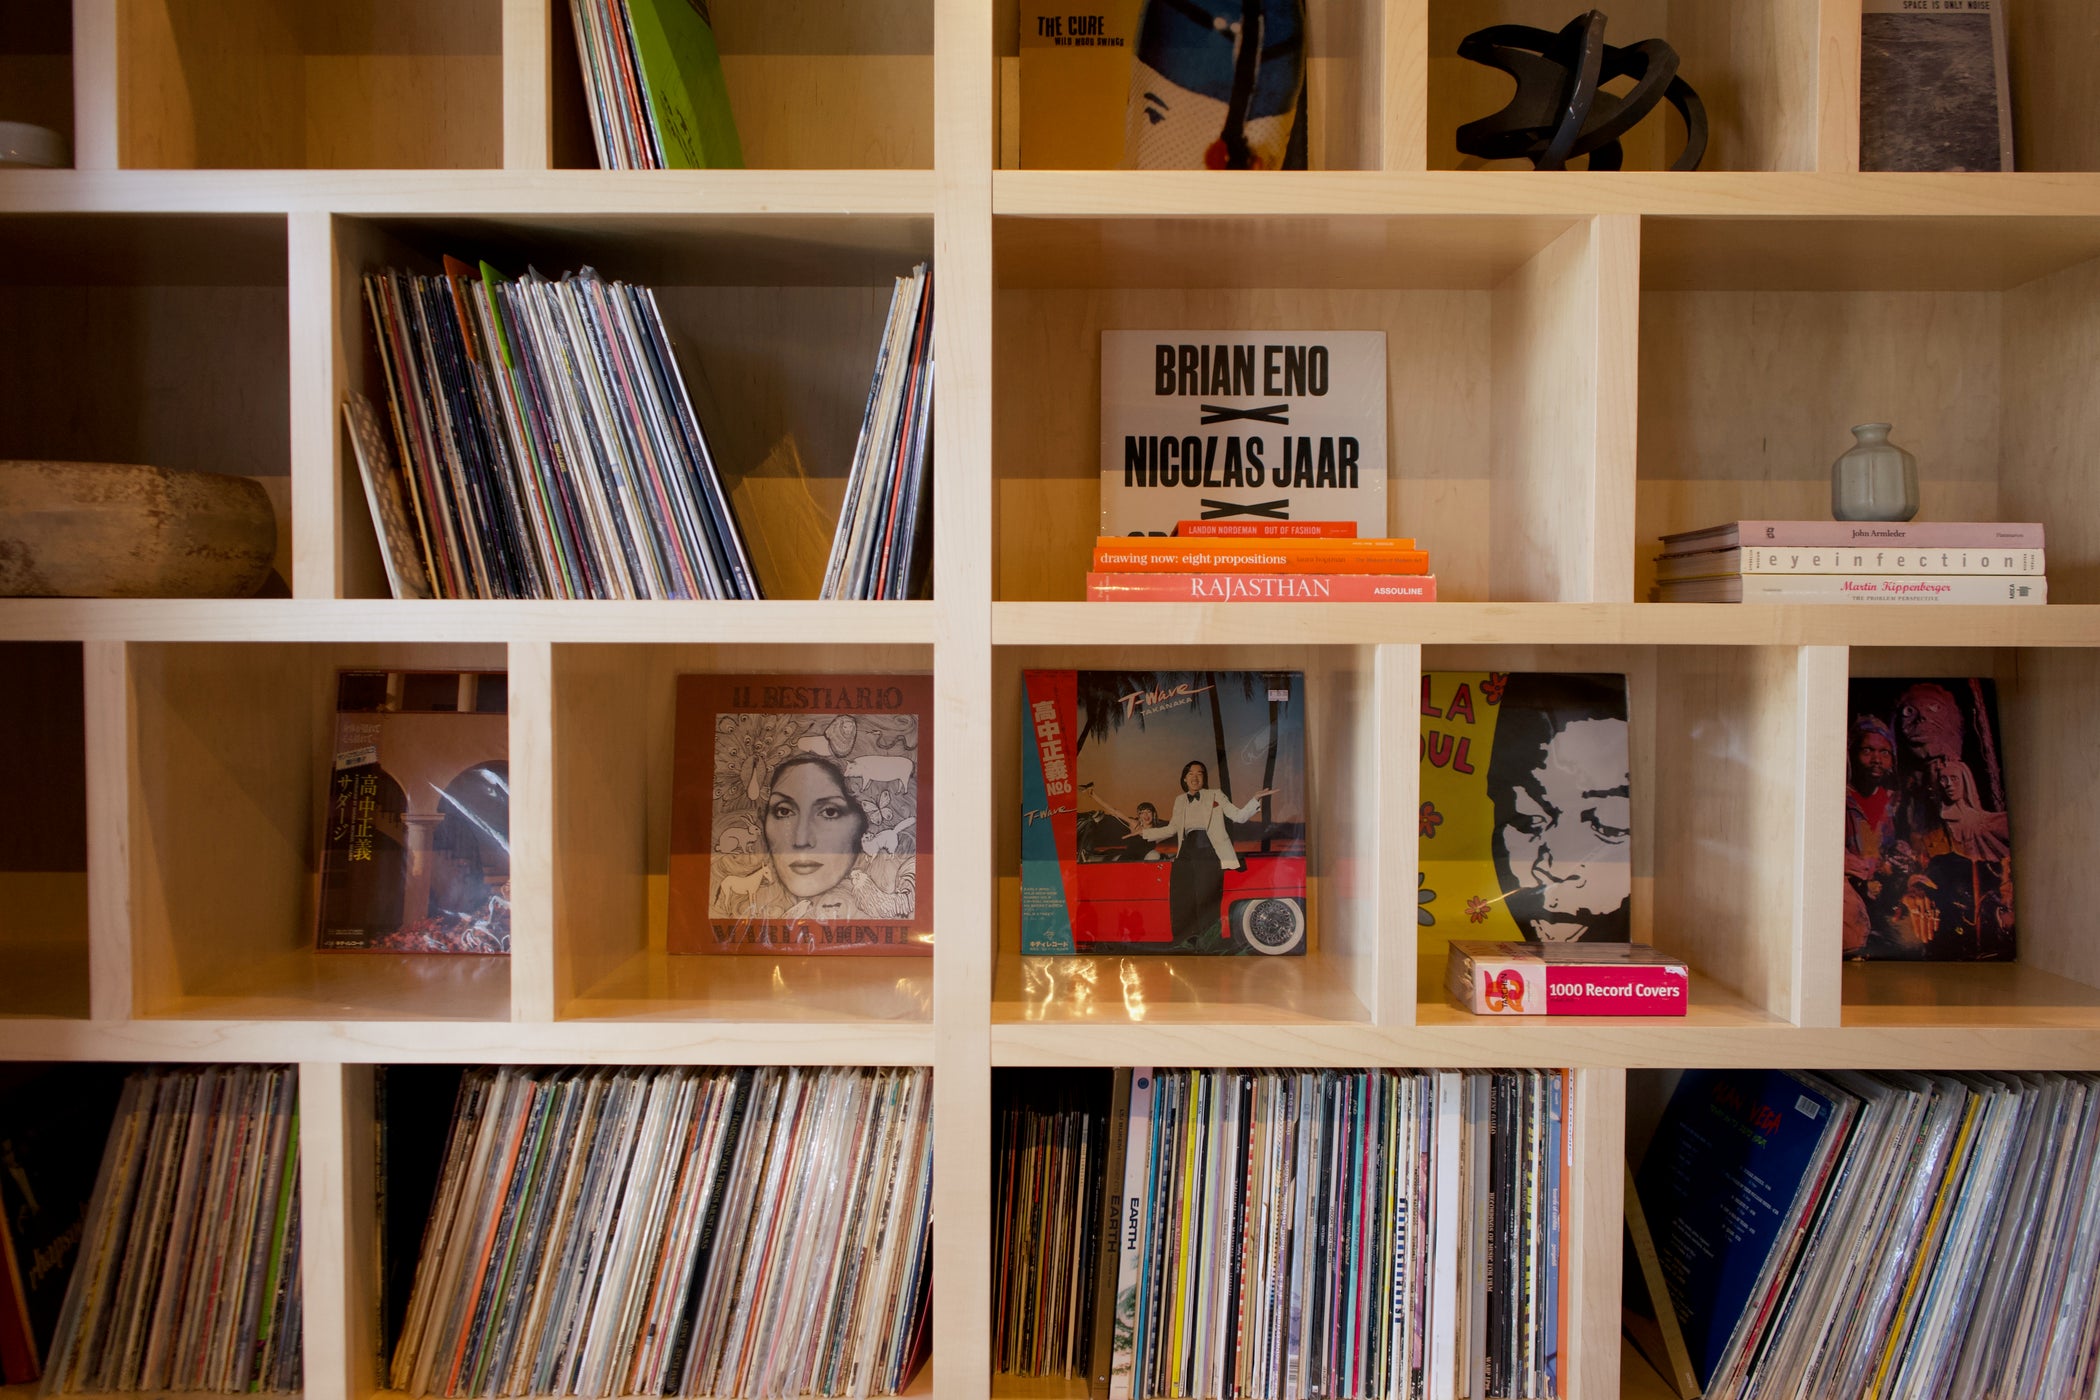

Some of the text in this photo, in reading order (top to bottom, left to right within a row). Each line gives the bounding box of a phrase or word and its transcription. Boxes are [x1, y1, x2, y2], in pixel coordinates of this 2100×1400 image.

[1904, 1, 1990, 10] SPACE IS ONLY NOISE
[1038, 15, 1105, 37] THE CURE
[1054, 37, 1124, 47] WILD MOOD SWINGS
[1155, 344, 1329, 396] BRIAN ENO
[1125, 436, 1359, 488] NICOLAS JAAR
[1189, 526, 1257, 535] LANDON NORDEMAN
[1264, 526, 1279, 535] OUT
[1280, 526, 1289, 535] OF
[1290, 526, 1322, 535] FASHION
[1852, 529, 1906, 539] John Armleder
[1100, 552, 1286, 566] drawing now: eight propositions
[1191, 577, 1330, 602] RAJASTHAN
[1374, 587, 1423, 595] ASSOULINE
[1840, 580, 1951, 594] Martin Kippenberger
[762, 686, 904, 709] BESTIARIO
[1140, 698, 1192, 716] TAKANAKA
[1032, 700, 1069, 783] 高中正義
[1420, 730, 1474, 775] UL
[334, 775, 352, 842] サダージ
[354, 774, 378, 862] 高中正義
[1550, 983, 1680, 998] 1000 Record Covers
[1107, 1195, 1120, 1252] EARTH
[1128, 1198, 1140, 1250] EARTH
